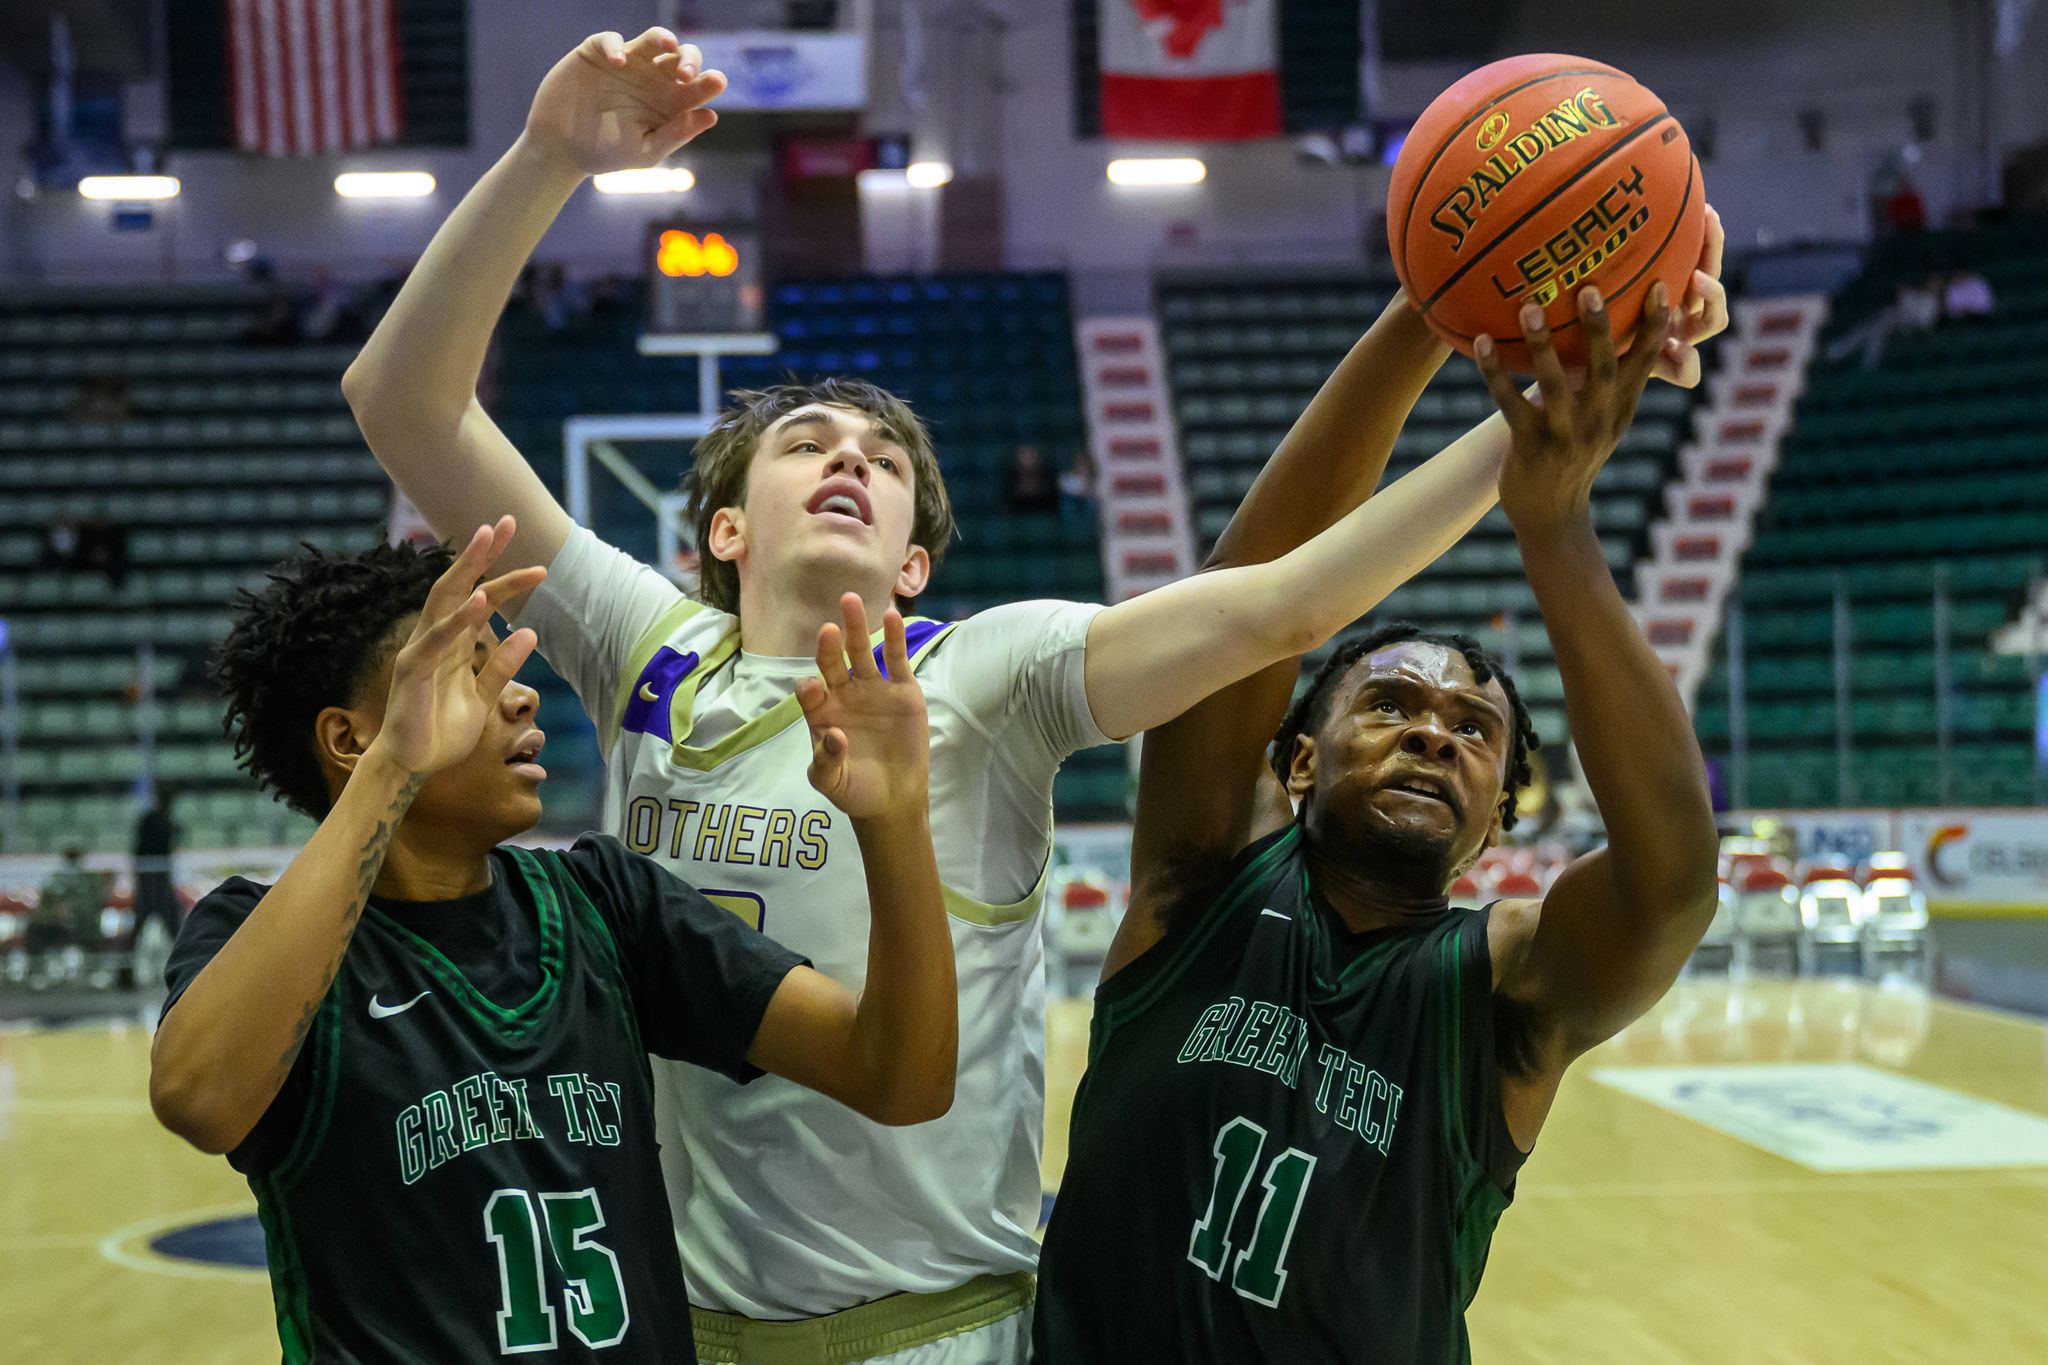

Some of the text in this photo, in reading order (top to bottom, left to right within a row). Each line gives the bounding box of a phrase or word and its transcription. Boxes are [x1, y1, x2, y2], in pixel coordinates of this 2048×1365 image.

[1429, 86, 1621, 252] SPALDING
[1491, 165, 1645, 299] LEGACY
[1559, 205, 1650, 290] 1000
[626, 795, 832, 871] OTHERS
[483, 1187, 630, 1355] 15
[1187, 1115, 1318, 1309] 11
